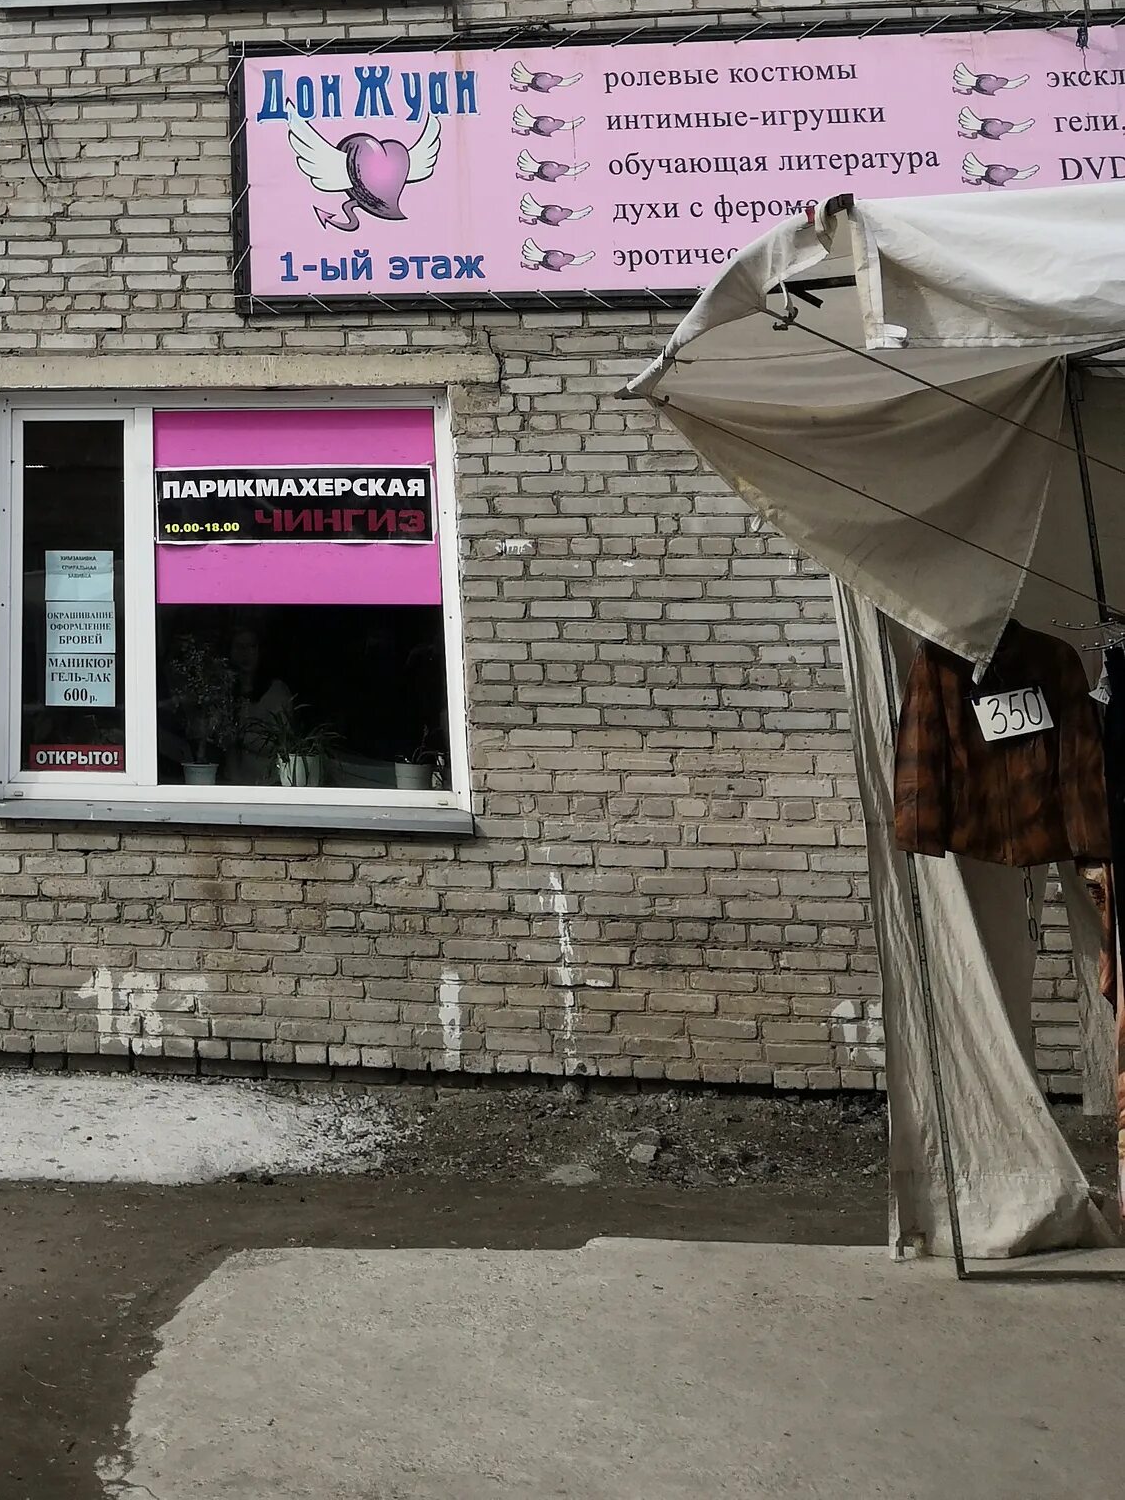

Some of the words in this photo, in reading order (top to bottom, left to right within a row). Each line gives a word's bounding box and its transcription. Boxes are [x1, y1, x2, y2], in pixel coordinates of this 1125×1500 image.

[604, 68, 719, 94] ролевые
[729, 63, 858, 84] костюмы
[257, 69, 342, 123] Дон
[354, 65, 480, 123] Жуан
[606, 105, 886, 131] интимные-игрушки
[608, 151, 768, 180] обучающая
[778, 149, 940, 176] литература
[612, 201, 681, 226] духи
[689, 200, 704, 218] с
[279, 249, 373, 282] 1-ый
[388, 254, 486, 281] этаж
[162, 477, 426, 500] ПАРИКМАХЕРСКАЯ
[163, 521, 241, 534] 10.00-18.00
[254, 508, 426, 533] ЧИНГИЗ
[47, 611, 114, 620] ОКРАШИВАНИЕ
[49, 622, 112, 631] ОФОРМЛЕНИЕ
[58, 633, 103, 645] БРОВЕЙ
[48, 657, 114, 669] МАНИКЮР
[50, 672, 112, 683] ГЕЛЬ-ЛАК
[63, 687, 88, 702] 600
[986, 689, 1043, 735] 350
[35, 750, 120, 765] ОТКРЫТО!
